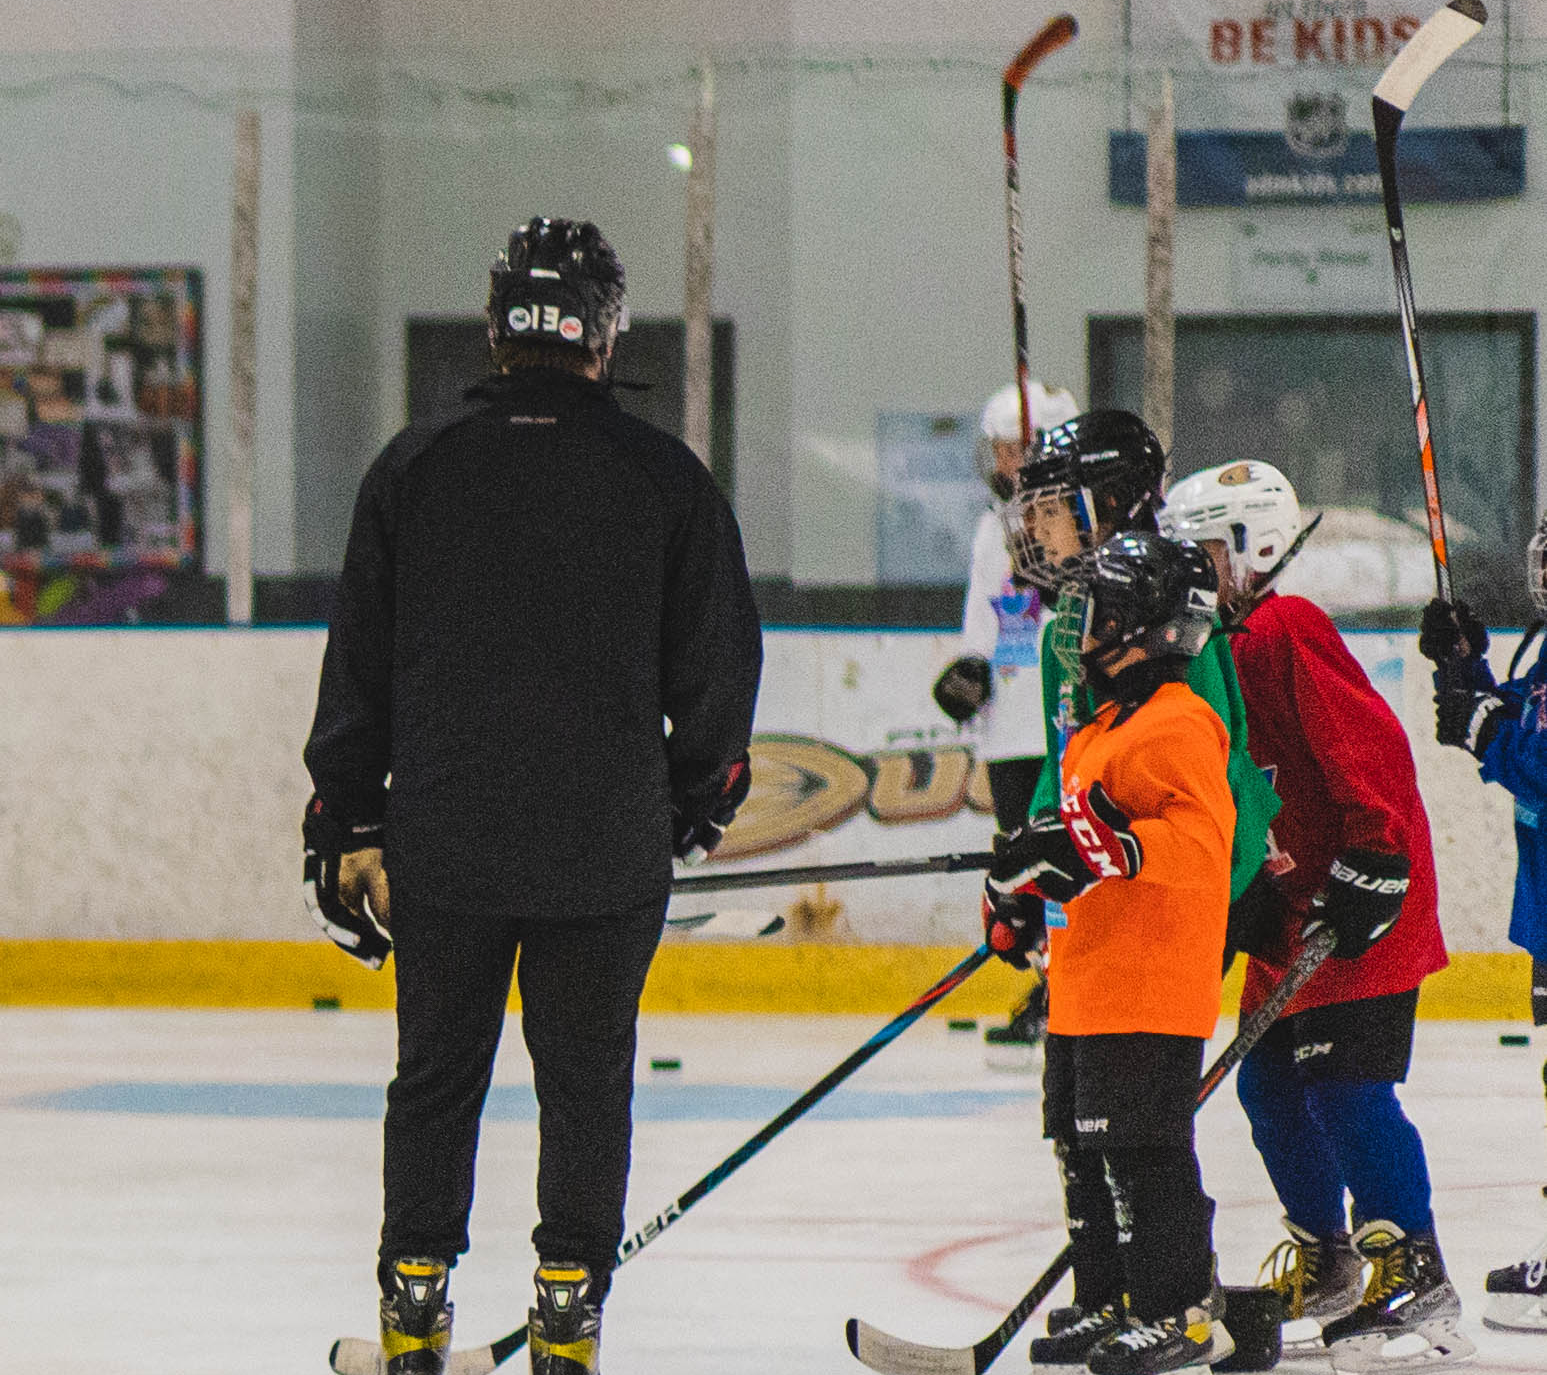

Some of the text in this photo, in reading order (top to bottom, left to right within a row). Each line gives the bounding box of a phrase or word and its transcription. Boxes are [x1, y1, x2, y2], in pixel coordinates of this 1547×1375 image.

[1210, 18, 1277, 64] BE
[531, 305, 560, 332] 13
[1074, 1118, 1109, 1134] UER
